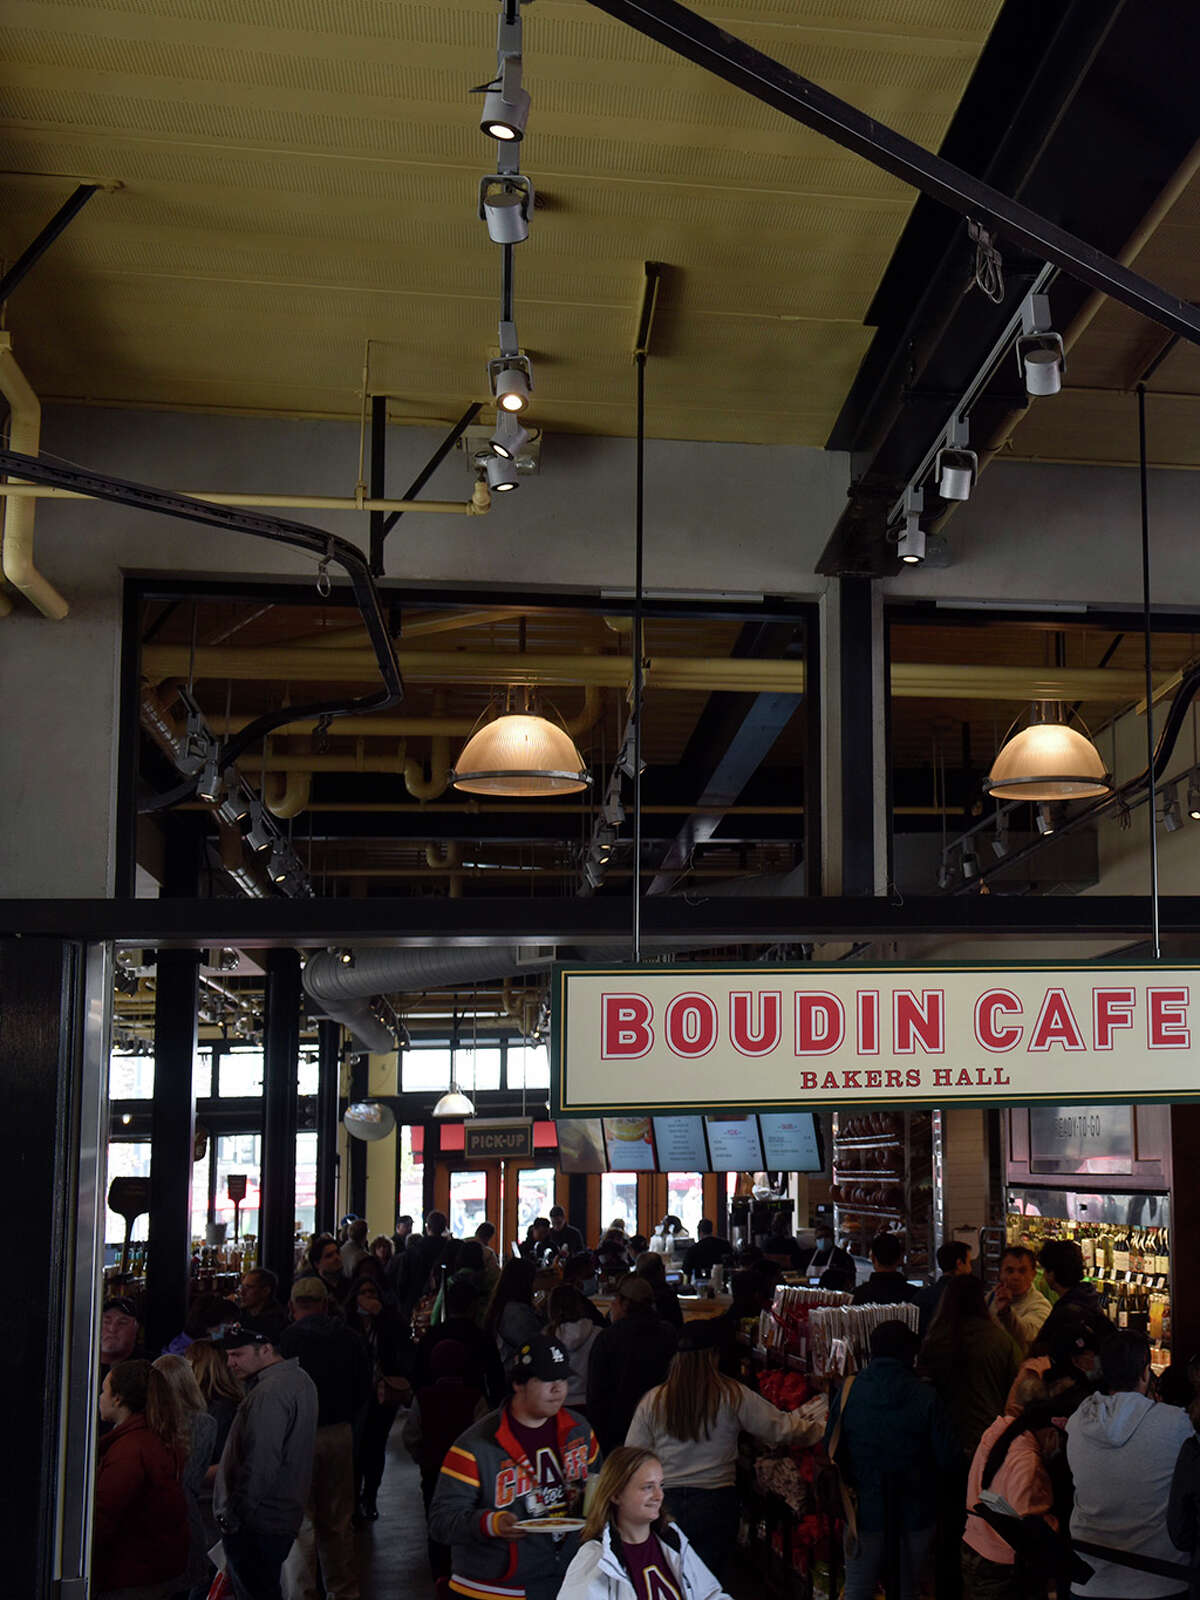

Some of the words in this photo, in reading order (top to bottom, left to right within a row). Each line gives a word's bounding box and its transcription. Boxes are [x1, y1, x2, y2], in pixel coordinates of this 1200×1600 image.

[601, 988, 946, 1060] BOUDIN
[973, 986, 1192, 1053] CAFE
[800, 1069, 922, 1090] BAKERS
[932, 1066, 1011, 1087] HALL
[471, 1134, 525, 1149] PICK-UP
